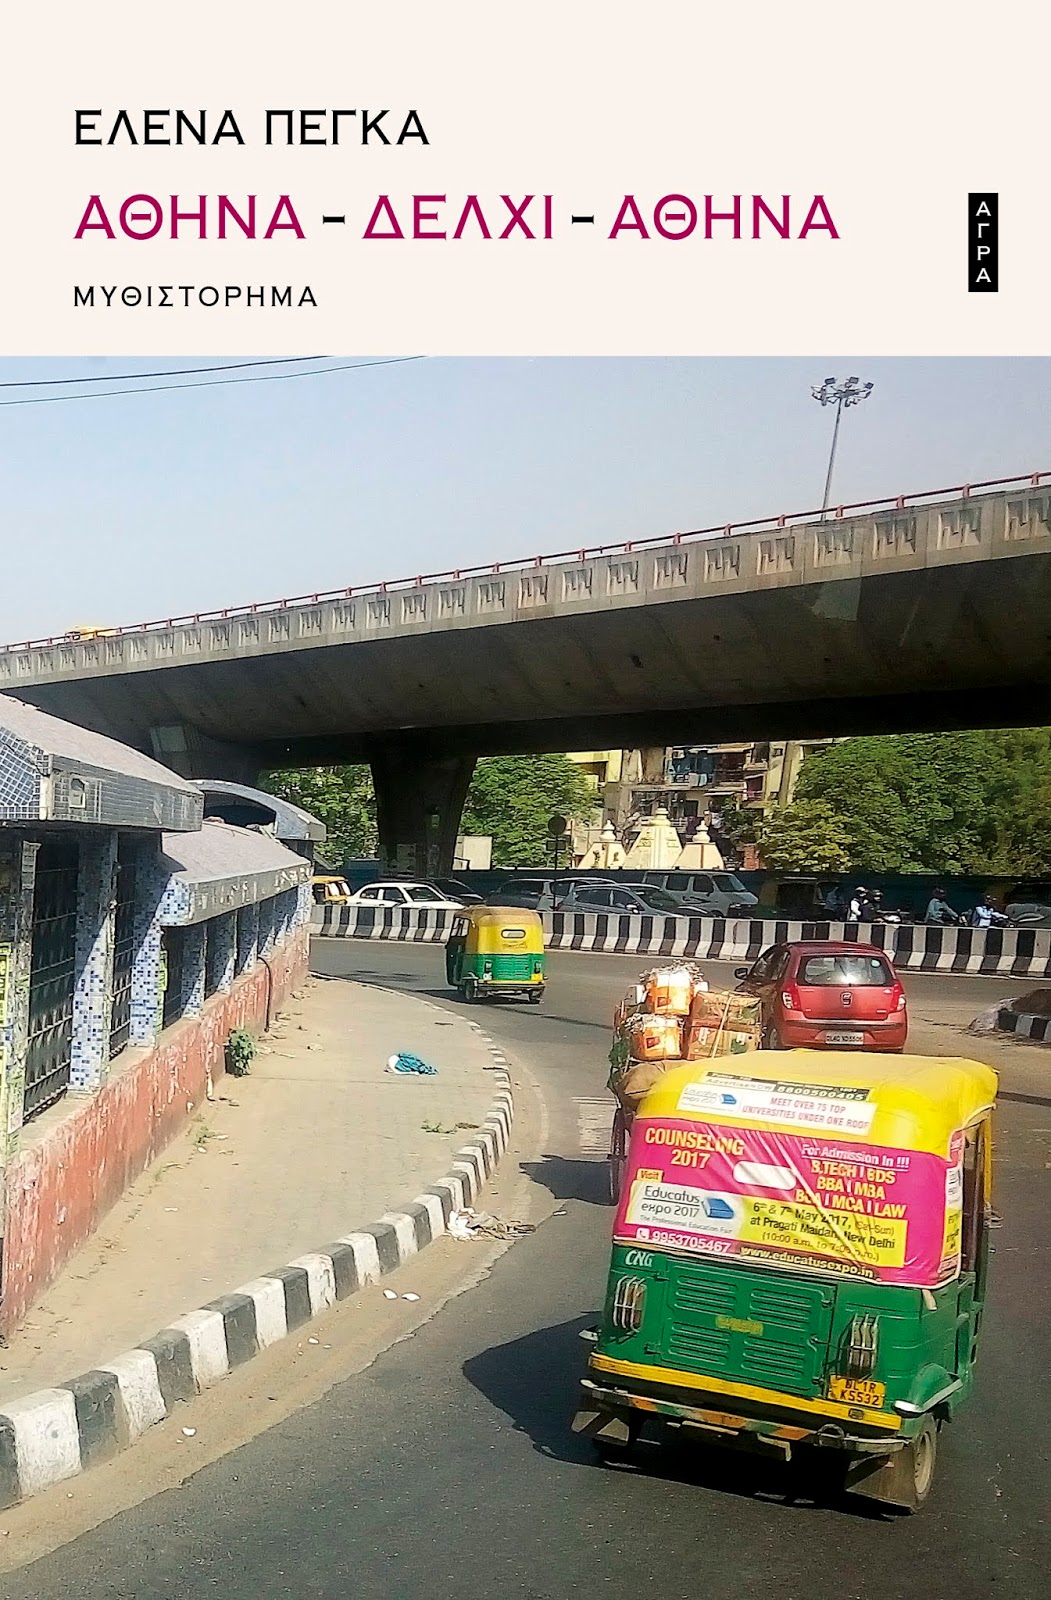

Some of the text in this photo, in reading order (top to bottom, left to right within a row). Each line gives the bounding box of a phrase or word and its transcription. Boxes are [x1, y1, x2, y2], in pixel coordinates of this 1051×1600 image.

[770, 1097, 846, 1113] MEET OVER 75 TOP
[776, 1085, 865, 1102] 8800500405
[742, 1106, 796, 1119] UNIVERSITIES
[798, 1111, 824, 1123] UNDER
[826, 1115, 845, 1126] ONE
[846, 1118, 870, 1129] ROOF
[671, 1149, 711, 1169] 2017
[801, 1143, 820, 1156] For
[820, 1146, 879, 1166] Admission
[881, 1155, 894, 1167] In
[640, 1170, 660, 1180] Visit
[810, 1159, 856, 1178] B.TECH
[867, 1168, 896, 1184] BDS
[644, 1185, 701, 1204] Educatus
[816, 1176, 845, 1193] BBA
[854, 1181, 886, 1200] MBA
[641, 1202, 700, 1218] expo 2017
[768, 1204, 777, 1214] &
[795, 1208, 819, 1224] May
[821, 1214, 852, 1230] 217,
[832, 1195, 865, 1212] MCA
[873, 1202, 907, 1219] LAW
[652, 1230, 732, 1254] 9953705467
[750, 1216, 761, 1226] at
[763, 1217, 798, 1232] Pragati
[869, 1236, 896, 1249] Delhi
[625, 1249, 656, 1268] CNG
[740, 1246, 874, 1279] www.educatusexpo.in
